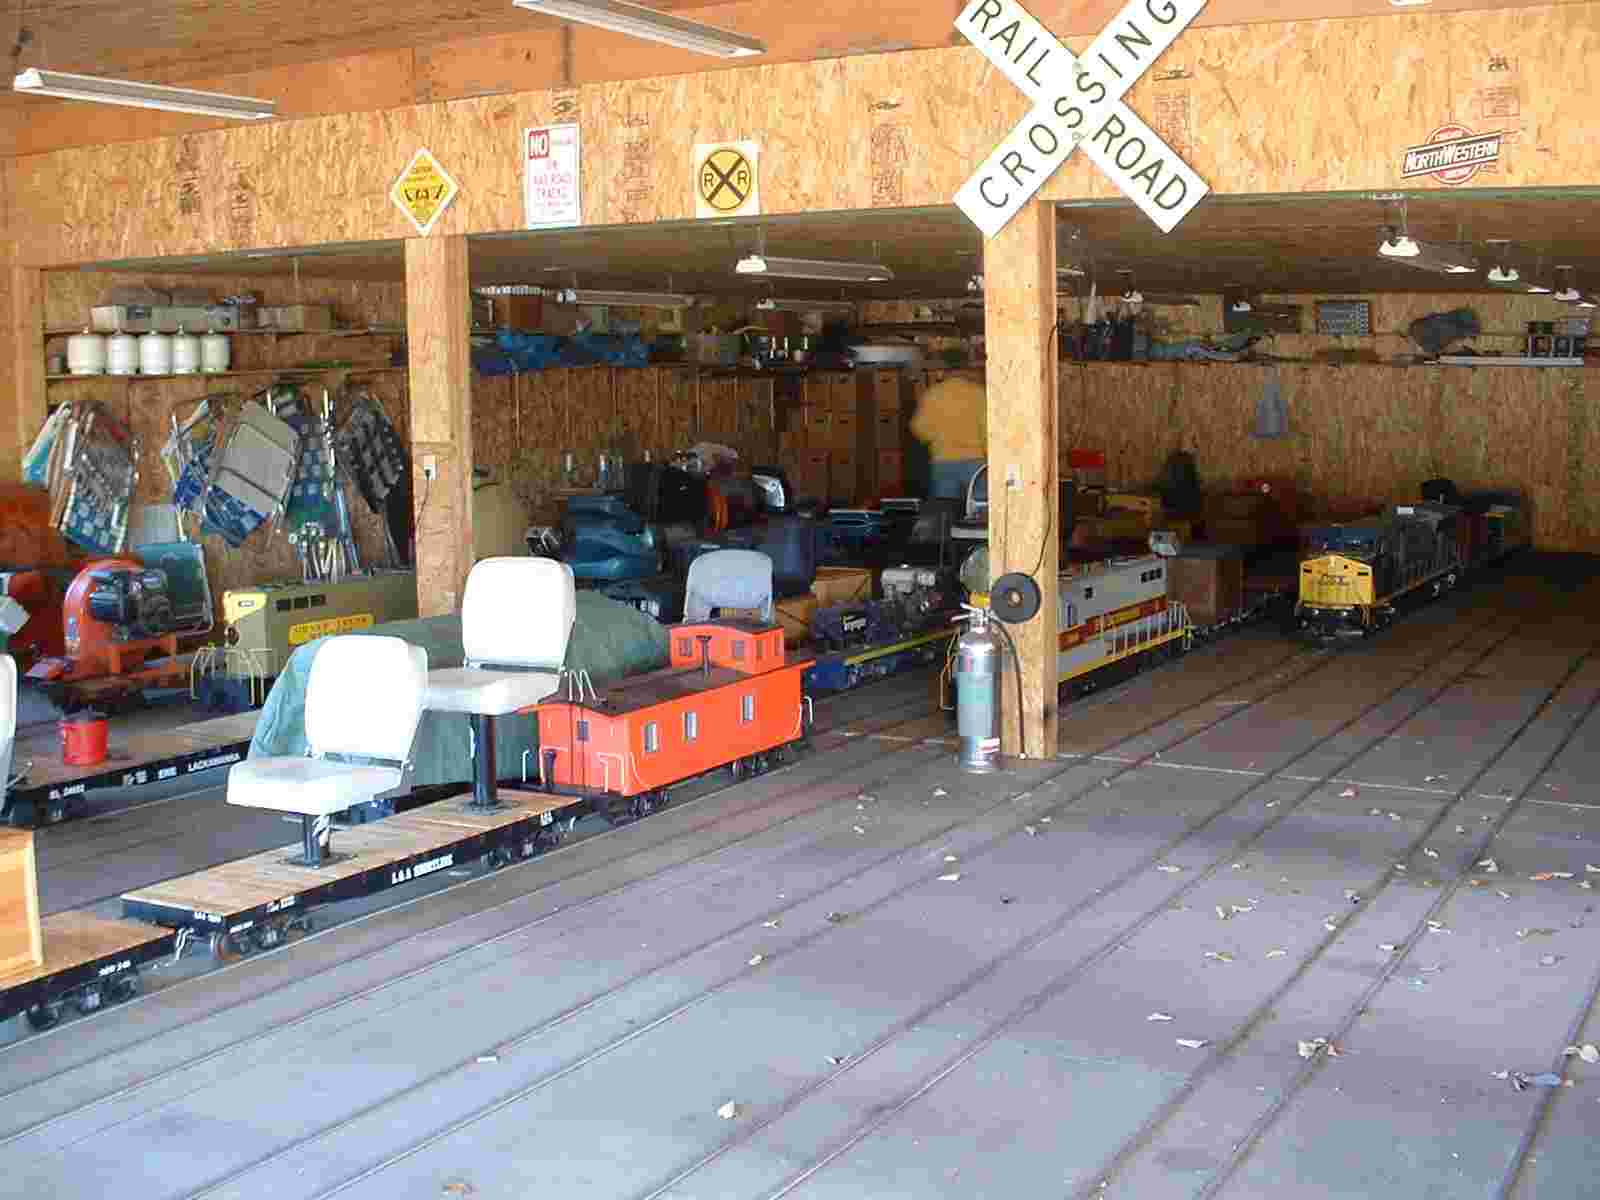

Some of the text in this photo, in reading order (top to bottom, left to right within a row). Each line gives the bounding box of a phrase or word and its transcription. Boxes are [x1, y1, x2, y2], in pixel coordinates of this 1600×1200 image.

[529, 133, 548, 157] NO
[969, 0, 1050, 87] RAIL
[1091, 113, 1187, 210] ROAD
[979, 0, 1177, 208] CROSSING
[704, 170, 747, 187] R R
